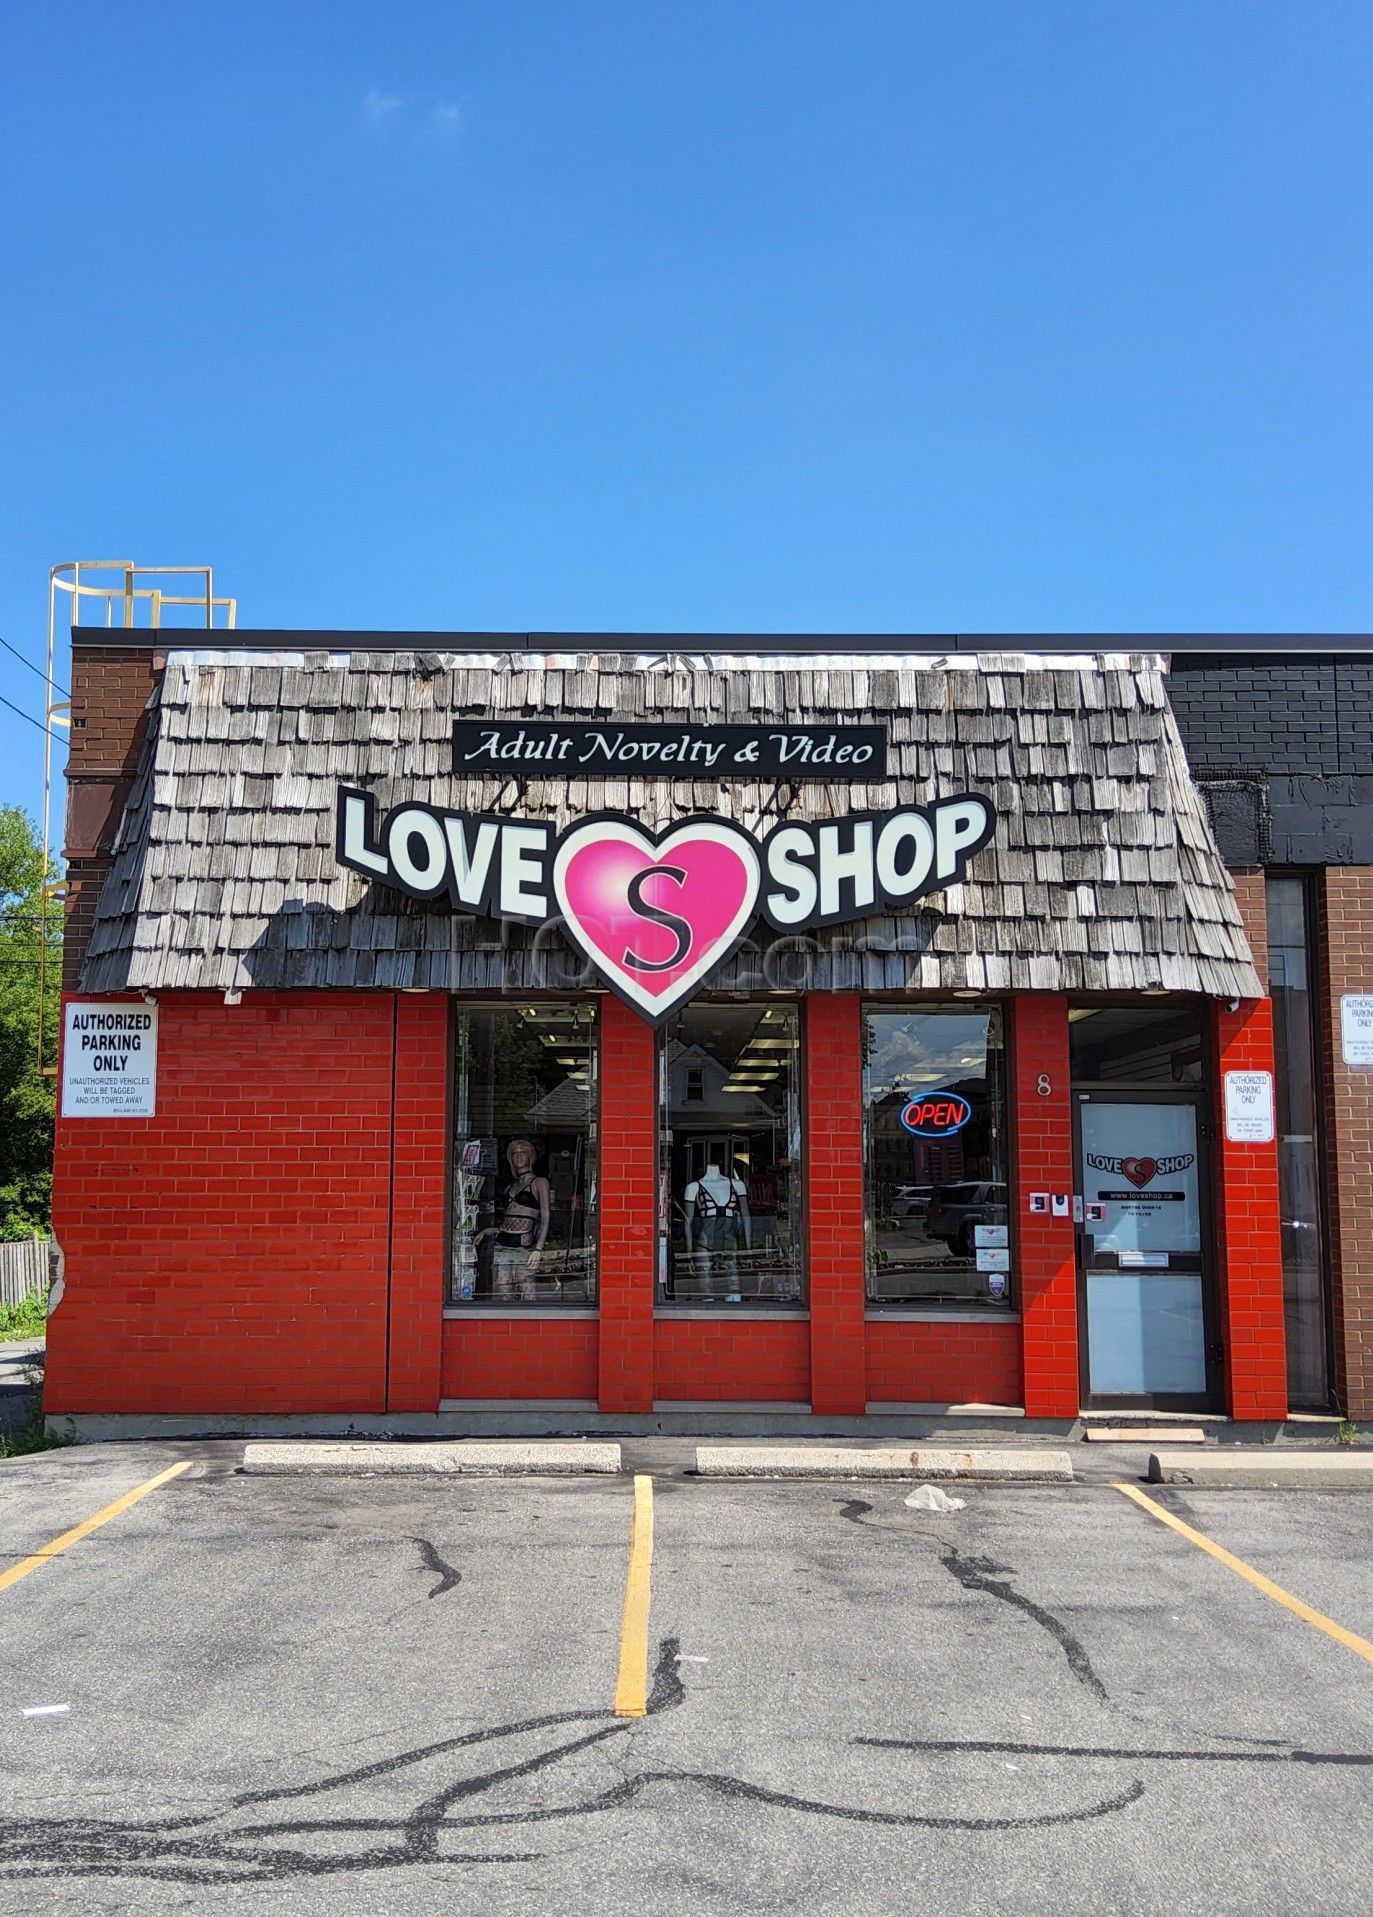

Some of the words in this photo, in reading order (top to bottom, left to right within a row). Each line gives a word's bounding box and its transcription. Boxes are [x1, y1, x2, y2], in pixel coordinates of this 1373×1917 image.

[464, 731, 573, 760] Adult
[578, 732, 726, 767] Novelty
[733, 739, 760, 762] &
[768, 734, 873, 763] Video
[344, 795, 548, 918] LOVE
[621, 863, 693, 973] S
[767, 800, 987, 924] SHOP
[72, 1014, 152, 1030] AUTHORIZED
[81, 1034, 141, 1051] PARKING
[93, 1055, 128, 1072] ONLY
[69, 1077, 118, 1085] UNAUTHORIZED
[119, 1077, 150, 1085] VEHICLES
[1036, 1073, 1052, 1096] 8
[1230, 1076, 1267, 1085] AUTHORIZED
[1235, 1086, 1262, 1094] PARKING
[75, 1096, 89, 1104] AND
[90, 1096, 100, 1104] OR
[101, 1096, 124, 1104] TOWED
[125, 1096, 143, 1104] AWAY
[1241, 1095, 1256, 1104] ONLY
[904, 1103, 964, 1126] OPEN
[1088, 1153, 1121, 1173] LOVE
[1156, 1154, 1194, 1175] SHOP
[1109, 1192, 1173, 1200] www.loveshop.ca
